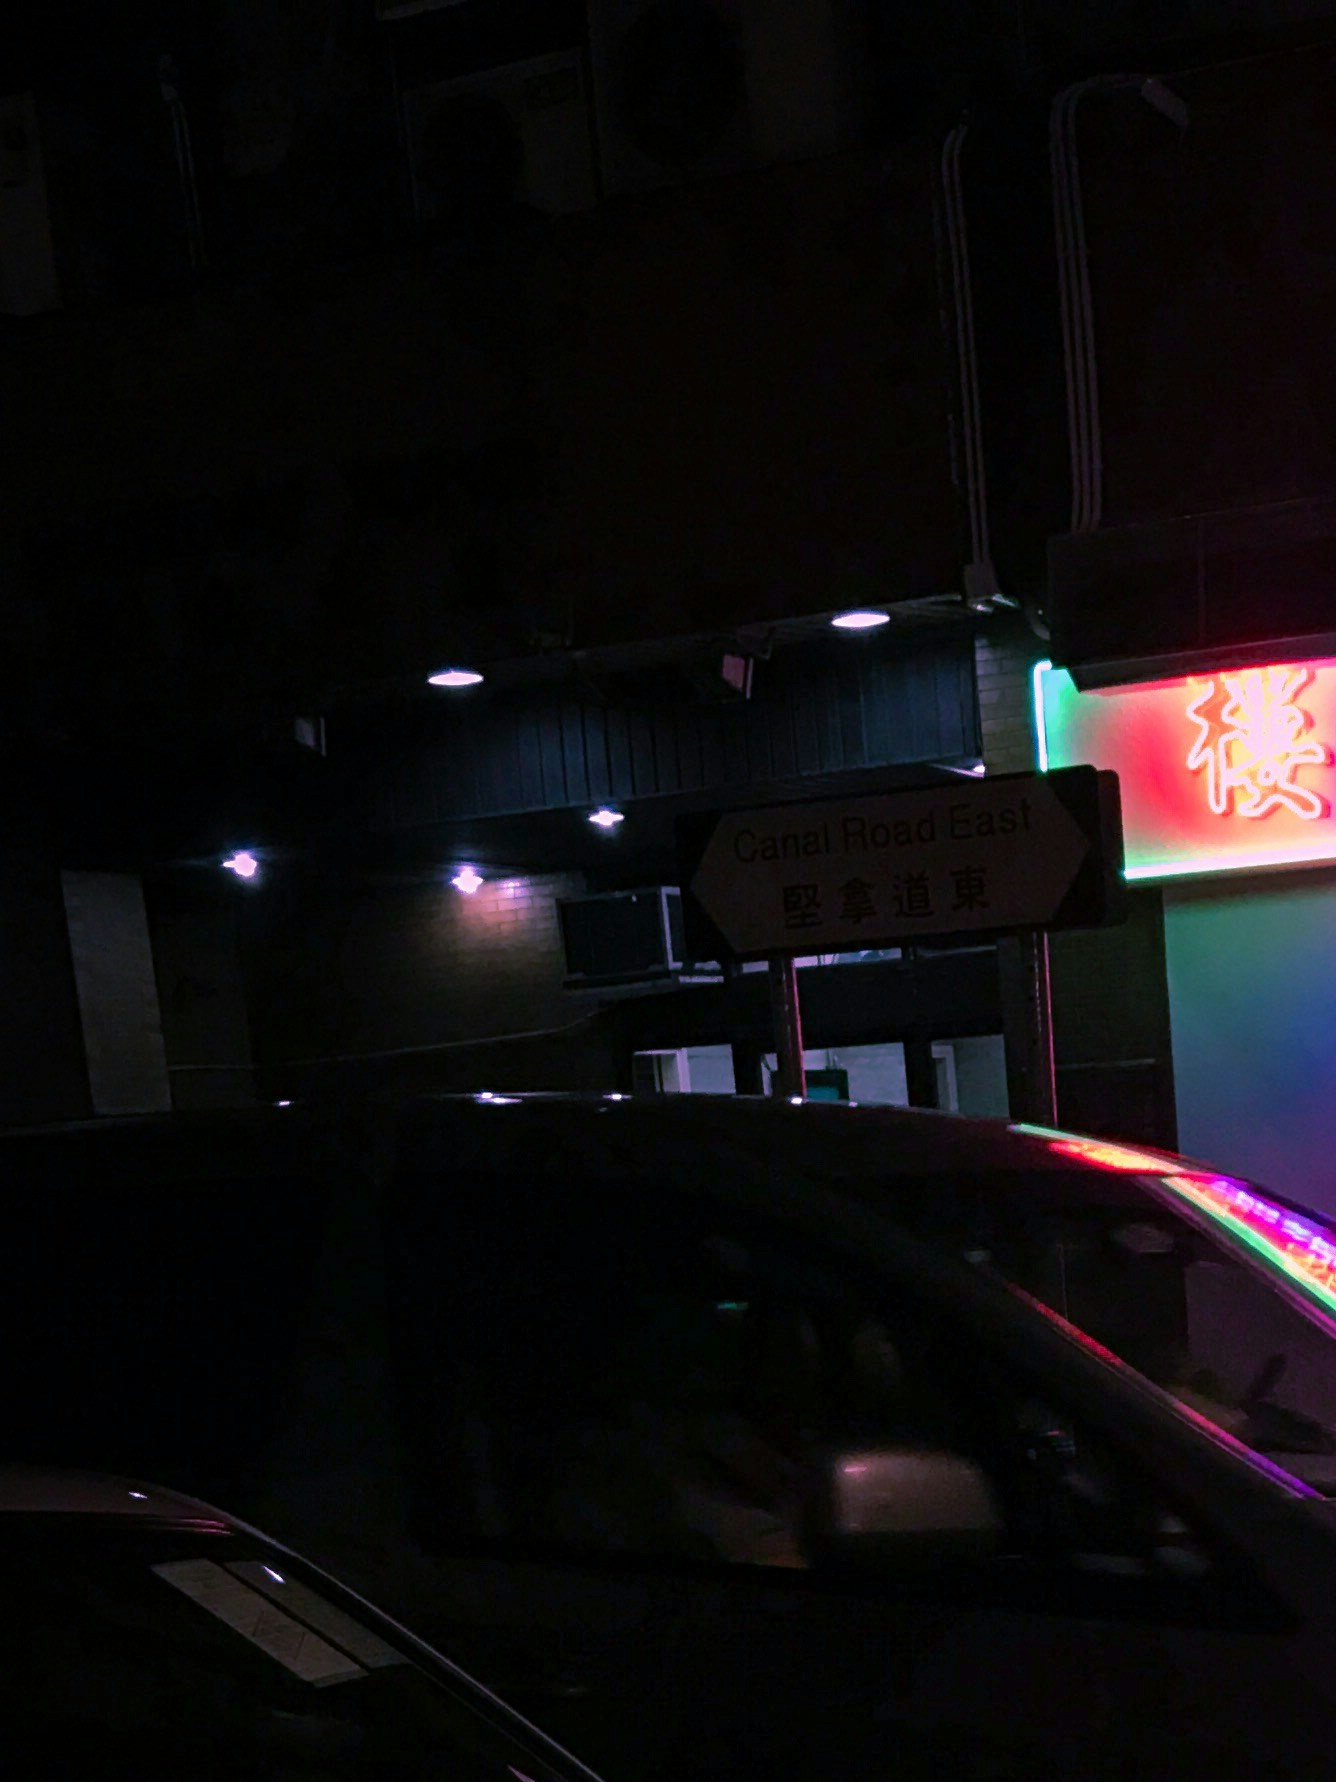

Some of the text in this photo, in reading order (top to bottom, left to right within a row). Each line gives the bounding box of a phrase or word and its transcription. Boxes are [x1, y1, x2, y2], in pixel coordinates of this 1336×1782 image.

[734, 798, 1032, 864] Canal Road East
[782, 864, 990, 930] 堅拿道東
